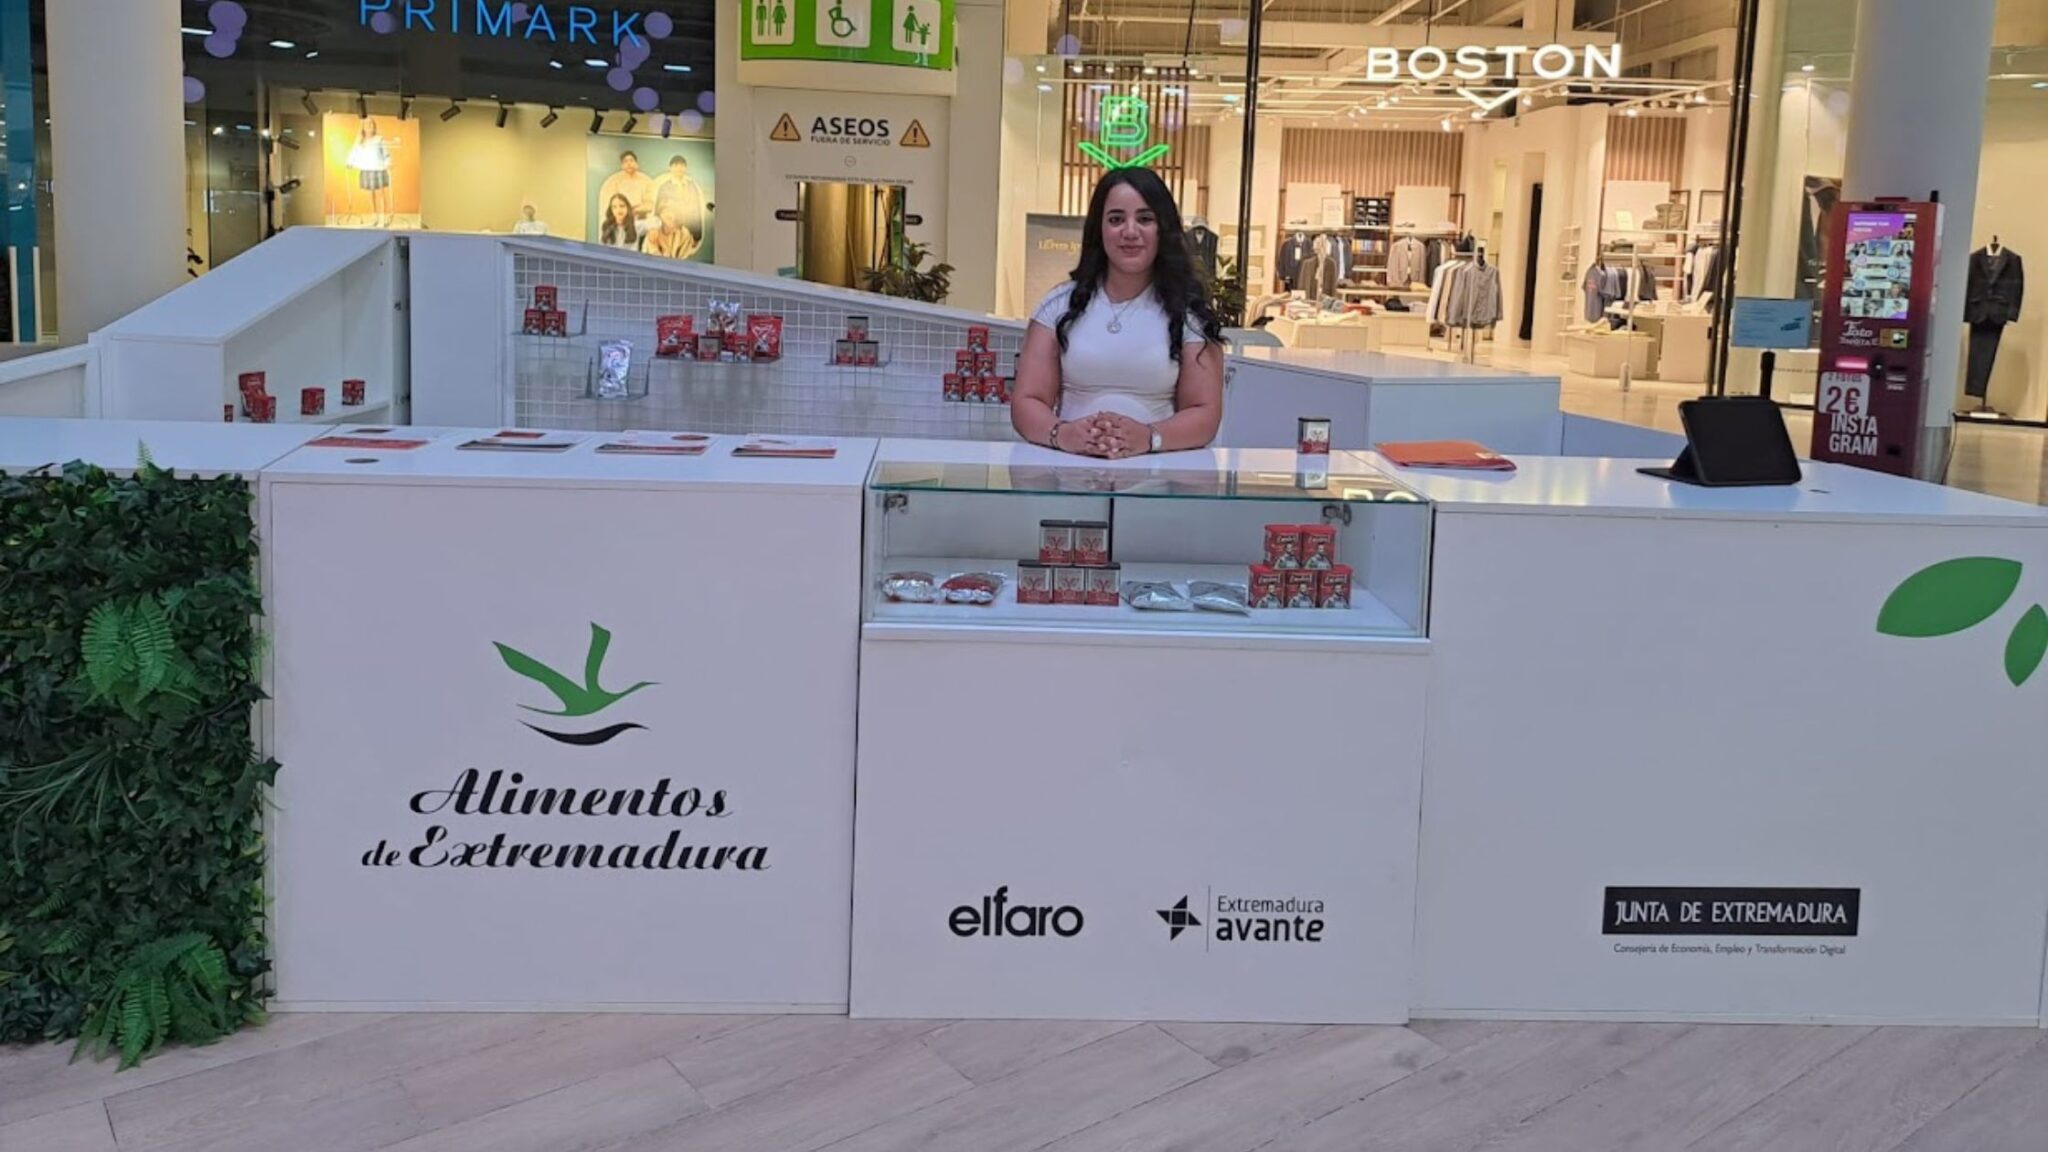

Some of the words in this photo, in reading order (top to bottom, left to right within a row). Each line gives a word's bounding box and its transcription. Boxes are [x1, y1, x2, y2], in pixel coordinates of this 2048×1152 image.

[359, 0, 642, 47] PRIMARK
[1366, 43, 1622, 80] BOSTON
[811, 116, 890, 137] ASEOS
[1100, 95, 1148, 147] B
[811, 135, 838, 144] FUERA
[840, 136, 851, 145] DE
[852, 137, 891, 146] SERVICIO
[1830, 412, 1878, 436] INSTA
[1828, 434, 1878, 457] GRAM
[409, 768, 734, 817] Alimentos
[361, 840, 401, 866] de
[408, 825, 771, 871] Extremadura
[949, 886, 1084, 937] elfaro
[1217, 896, 1324, 914] Extremadura
[1615, 901, 1670, 926] JUNTA
[1680, 901, 1702, 923] DE
[1711, 902, 1847, 924] EXTREMADURA
[1216, 916, 1324, 942] avante
[1658, 944, 1669, 953] de
[1715, 943, 1746, 955] Empleo
[1747, 946, 1753, 956] y
[1820, 944, 1846, 956] Digital
